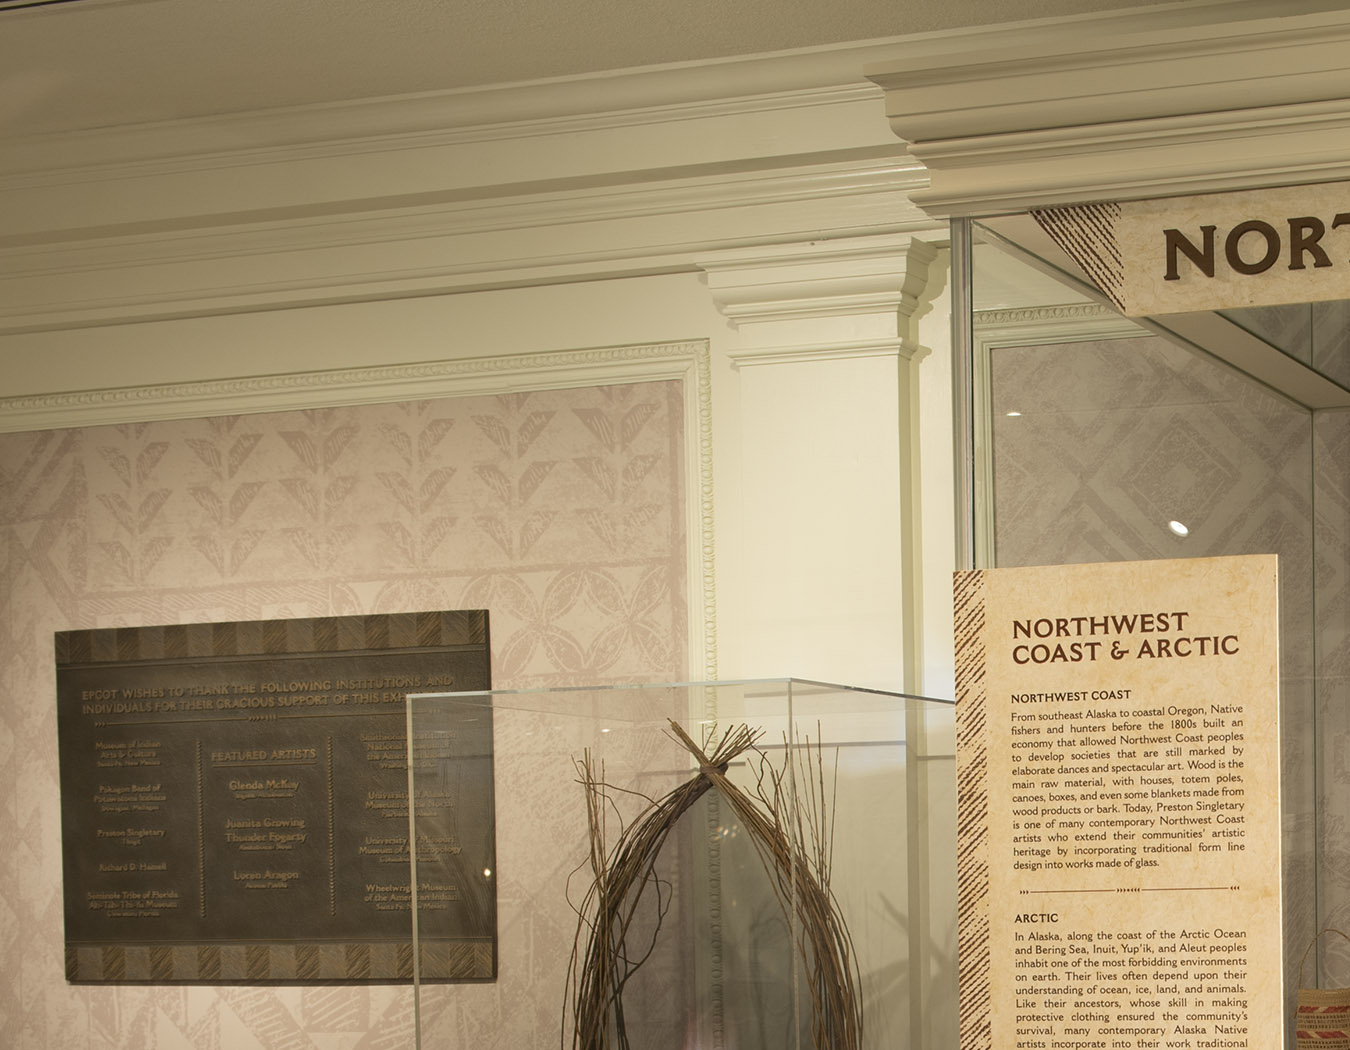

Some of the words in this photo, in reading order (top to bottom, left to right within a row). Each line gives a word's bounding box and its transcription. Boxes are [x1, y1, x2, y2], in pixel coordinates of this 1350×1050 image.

[1013, 612, 1189, 639] NORTHWEST
[1012, 642, 1102, 665] COAST
[1110, 640, 1129, 660] &
[1136, 635, 1239, 659] ARCTIC
[82, 689, 118, 701] EPCOT
[122, 687, 164, 699] WISHES
[168, 686, 184, 697] TO
[188, 684, 229, 696] THANK
[232, 683, 255, 695] THE
[261, 680, 331, 694] FOLLOWING
[336, 677, 421, 691] INSTITUTIONS
[427, 676, 453, 687] AND
[1011, 691, 1088, 704] NORTHWEST
[1091, 690, 1131, 701] COAST
[83, 702, 151, 715] INDIVIDUALS
[155, 701, 176, 712] FOR
[180, 699, 214, 711] THEIR
[216, 697, 275, 710] GRACIOUS
[279, 695, 329, 708] SUPPORT
[333, 695, 349, 706] OF
[352, 694, 380, 705] THIS
[1011, 712, 1036, 722] From
[1038, 711, 1083, 721] southeast
[1085, 709, 1117, 719] Alaska
[1119, 710, 1130, 718] to
[1132, 706, 1165, 717] coastal
[1167, 706, 1207, 717] Oregon,
[1211, 704, 1243, 714] Native
[1011, 725, 1041, 736] fishers
[1046, 724, 1064, 734] and
[1070, 724, 1106, 733] hunters
[1112, 721, 1142, 732] before
[1148, 720, 1164, 730] the
[1171, 719, 1197, 730] 1800s
[1203, 718, 1225, 728] built
[1011, 741, 1054, 750] economy
[1056, 738, 1076, 747] that
[1079, 736, 1116, 746] allowed
[1120, 734, 1172, 745] Northwest
[1175, 733, 1204, 743] Coast
[1207, 731, 1244, 744] peoples
[211, 750, 267, 761] FEATURED
[271, 748, 316, 760] ARTISTS
[1011, 754, 1022, 762] to
[1028, 751, 1065, 763] develop
[1071, 750, 1111, 760] societies
[1117, 749, 1137, 759] that
[1143, 750, 1159, 758] are
[1165, 747, 1182, 757] still
[1189, 745, 1226, 756] marked
[1232, 745, 1244, 757] by
[1012, 766, 1055, 776] elaborate
[1057, 764, 1090, 774] dances
[1091, 763, 1109, 773] and
[1111, 762, 1165, 774] spectacular
[1167, 762, 1184, 771] art.
[1187, 759, 1216, 770] Wood
[1218, 759, 1226, 769] is
[1228, 759, 1244, 768] the
[1014, 913, 1059, 923] ARCTIC
[1015, 932, 1024, 941] In
[1028, 931, 1062, 942] Alaska,
[1067, 931, 1093, 942] along
[1096, 931, 1113, 940] the
[1116, 932, 1142, 940] coast
[1145, 930, 1158, 940] of
[1160, 930, 1176, 939] the
[1179, 929, 1210, 939] Arctic
[1214, 929, 1246, 939] Ocean
[1014, 945, 1032, 955] and
[1035, 945, 1066, 956] Bering
[1069, 944, 1089, 955] Sea,
[1093, 944, 1119, 954] Inuit,
[1158, 943, 1176, 953] and
[1179, 943, 1207, 953] Aleut
[1209, 942, 1247, 954] peoples
[1015, 958, 1048, 968] inhabit
[1071, 958, 1083, 968] of
[1083, 958, 1100, 968] the
[1102, 959, 1126, 967] most
[1128, 957, 1178, 969] forbidding
[1180, 956, 1247, 966] environments
